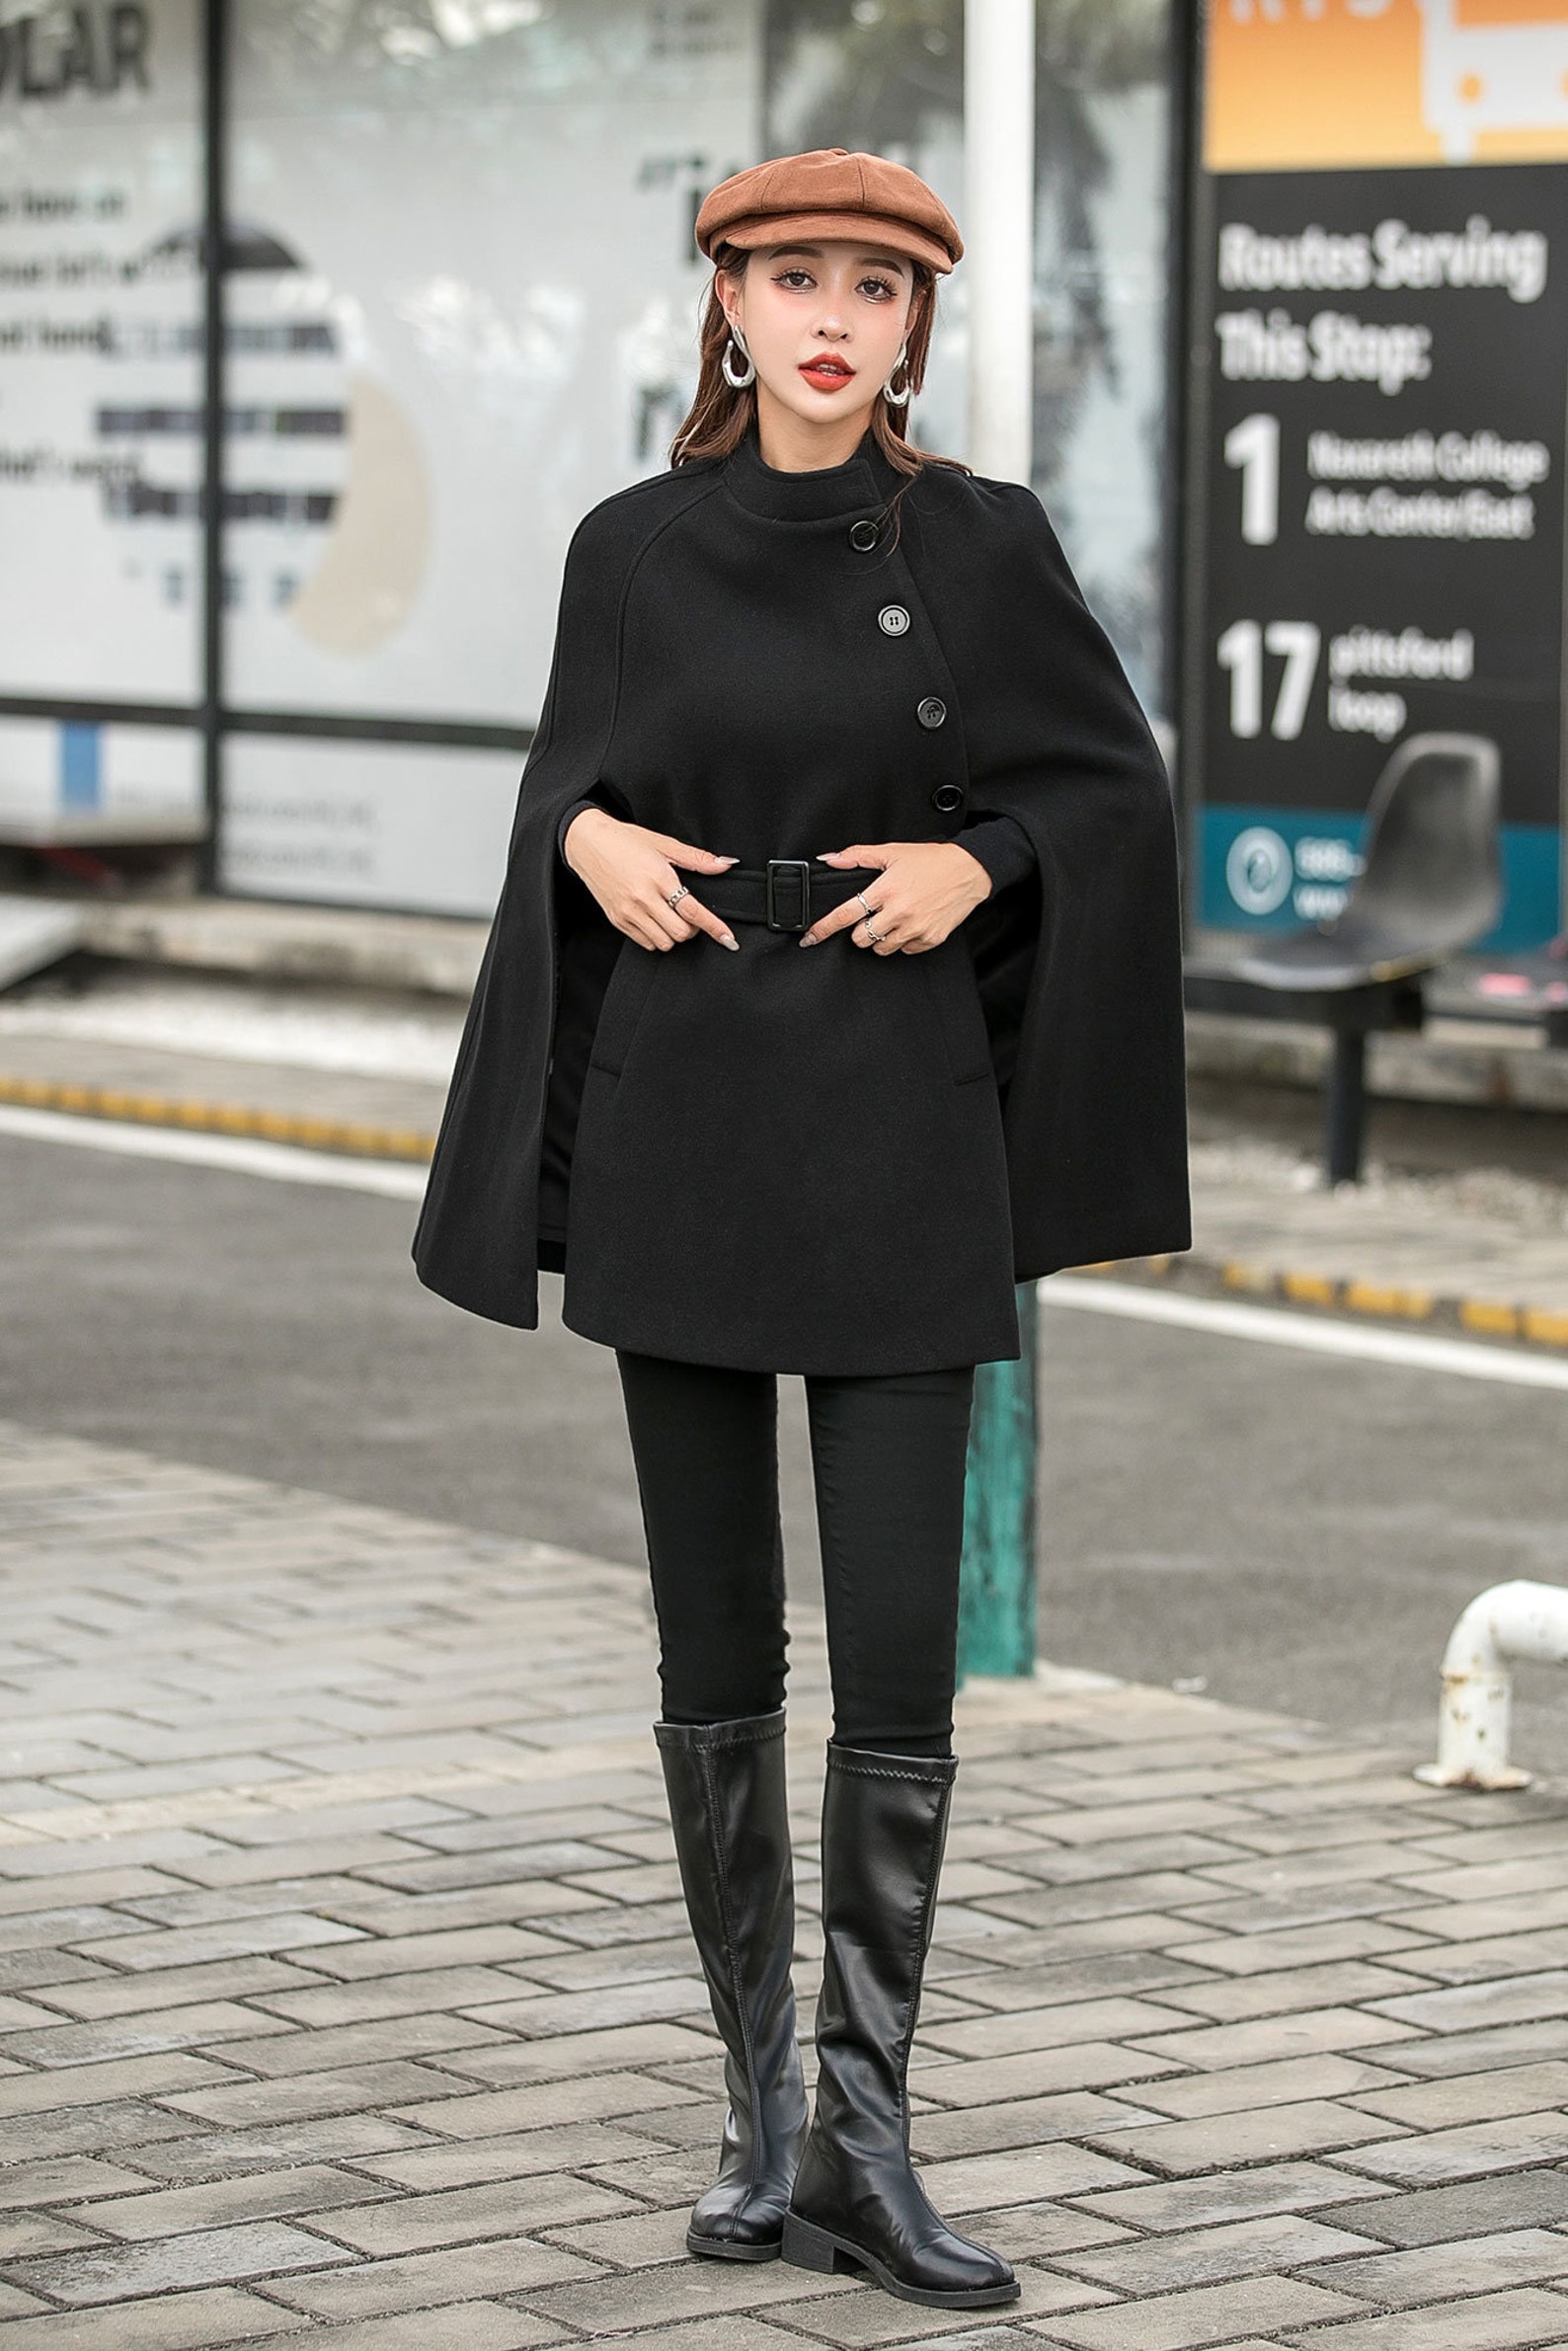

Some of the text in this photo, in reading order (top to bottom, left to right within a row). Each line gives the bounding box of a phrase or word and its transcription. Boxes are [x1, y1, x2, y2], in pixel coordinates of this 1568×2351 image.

[1218, 214, 1547, 302] Routes Serving
[1215, 310, 1432, 394] This Stop:
[1224, 413, 1280, 545] 1
[1437, 431, 1549, 492] College
[1217, 620, 1320, 741] 17
